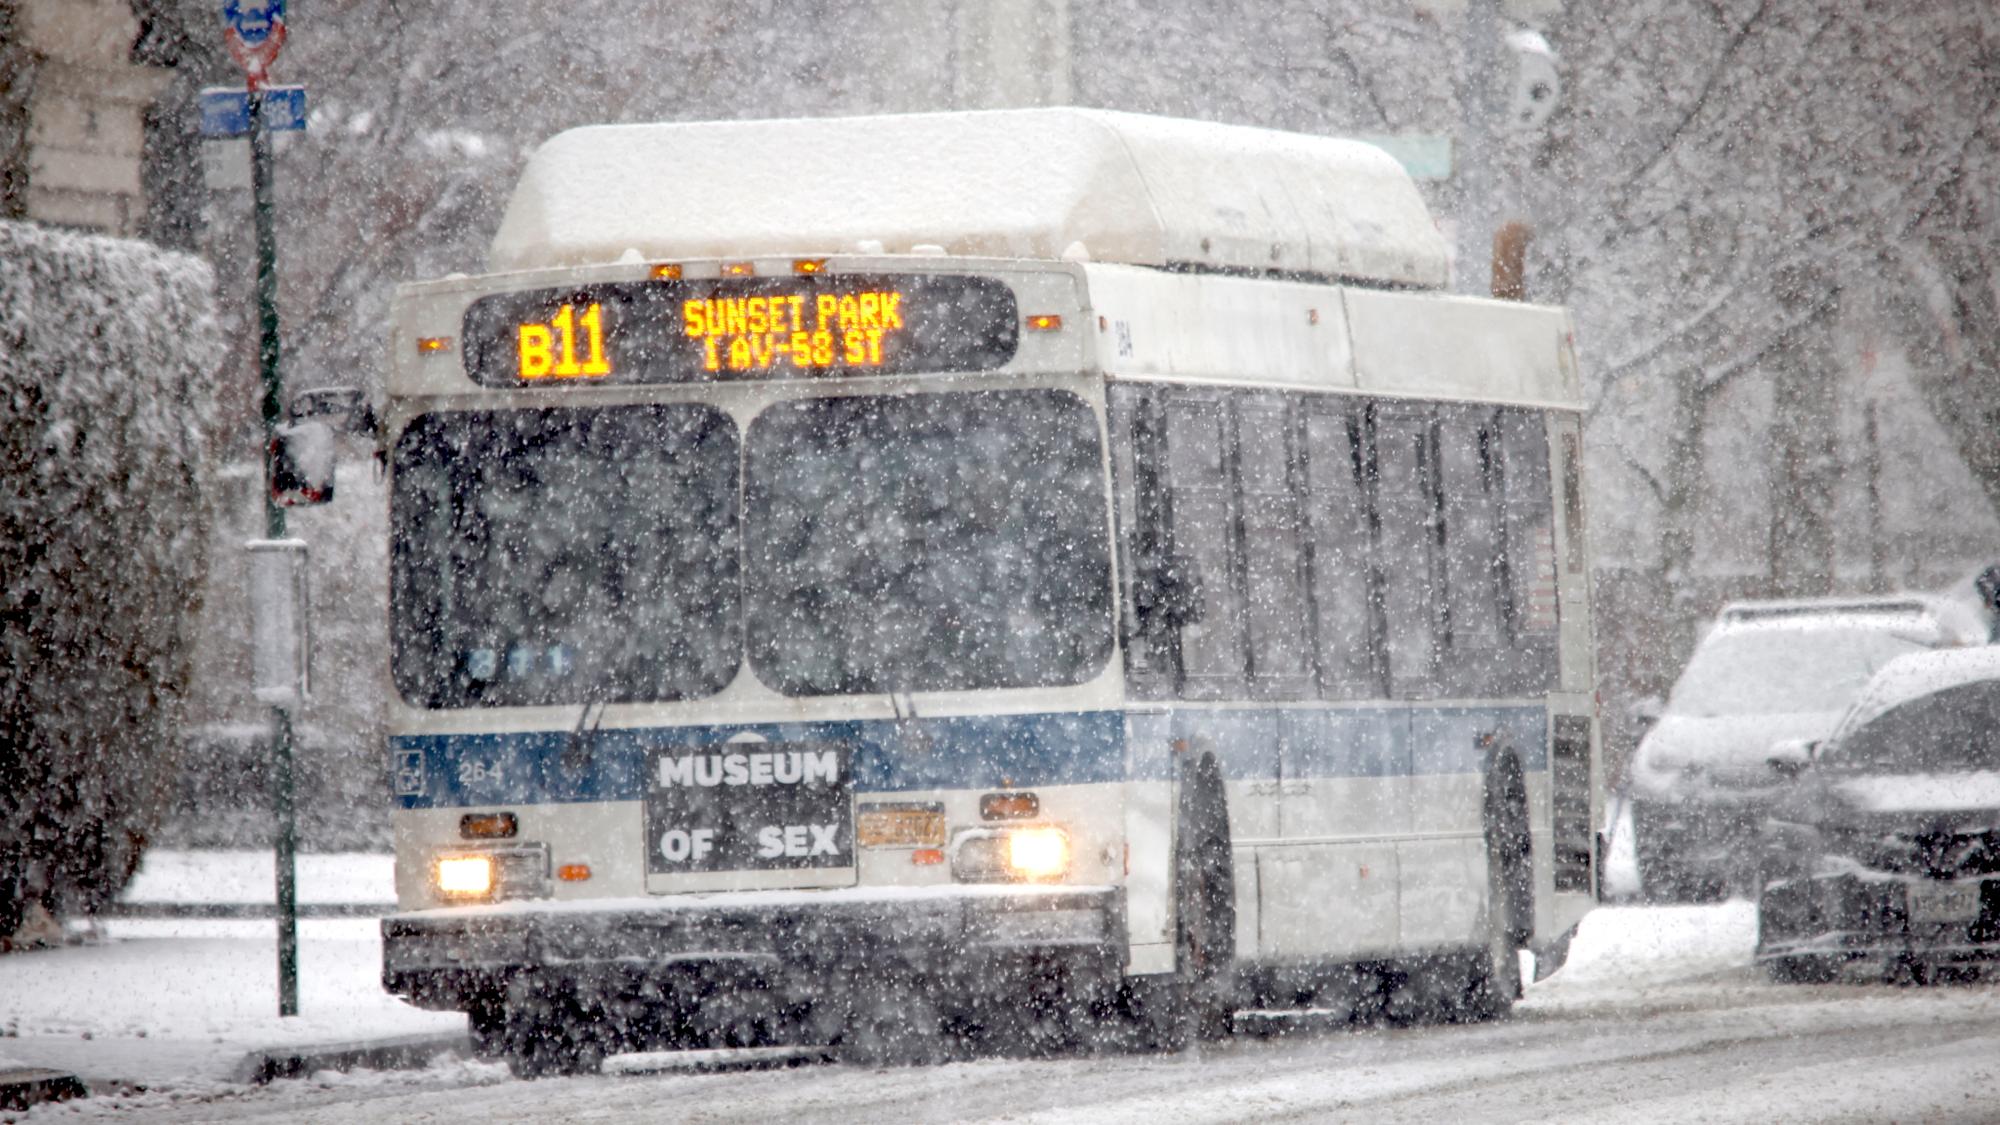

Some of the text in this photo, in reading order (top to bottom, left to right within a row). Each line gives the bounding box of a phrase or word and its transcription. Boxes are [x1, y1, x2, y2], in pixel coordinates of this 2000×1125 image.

[683, 292, 903, 336] SUNSET PARK
[518, 303, 611, 379] B11
[704, 329, 884, 371] 1 AV-58 ST
[659, 751, 838, 788] MUSEUM
[660, 828, 714, 862] OF
[758, 822, 840, 858] SEX
